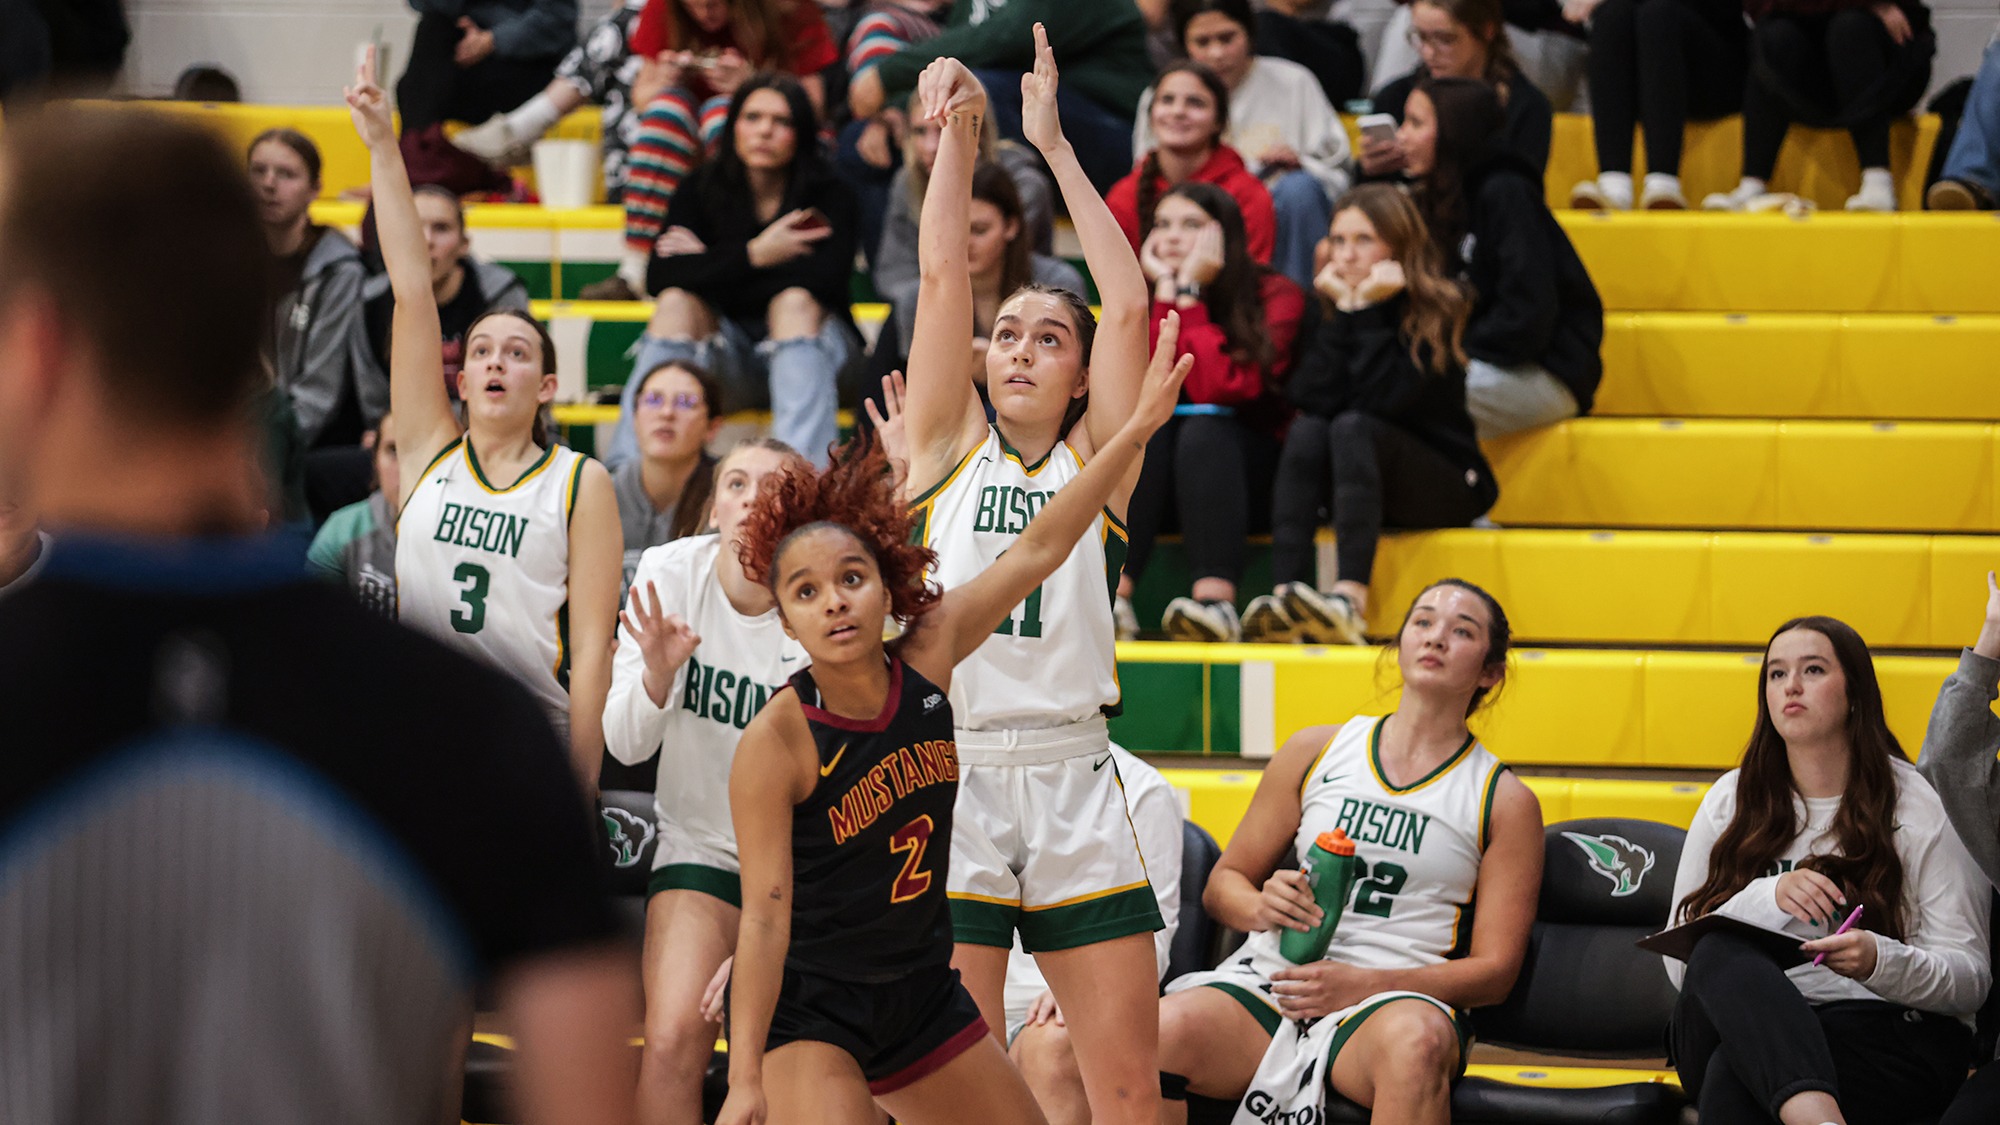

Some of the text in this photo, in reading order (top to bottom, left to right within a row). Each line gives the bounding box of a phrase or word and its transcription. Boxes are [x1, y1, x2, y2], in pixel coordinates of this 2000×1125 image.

[433, 502, 529, 558] BISON
[973, 485, 1057, 534] BISO
[450, 561, 490, 634] 3
[1334, 797, 1431, 854] BISON
[889, 813, 934, 904] 2
